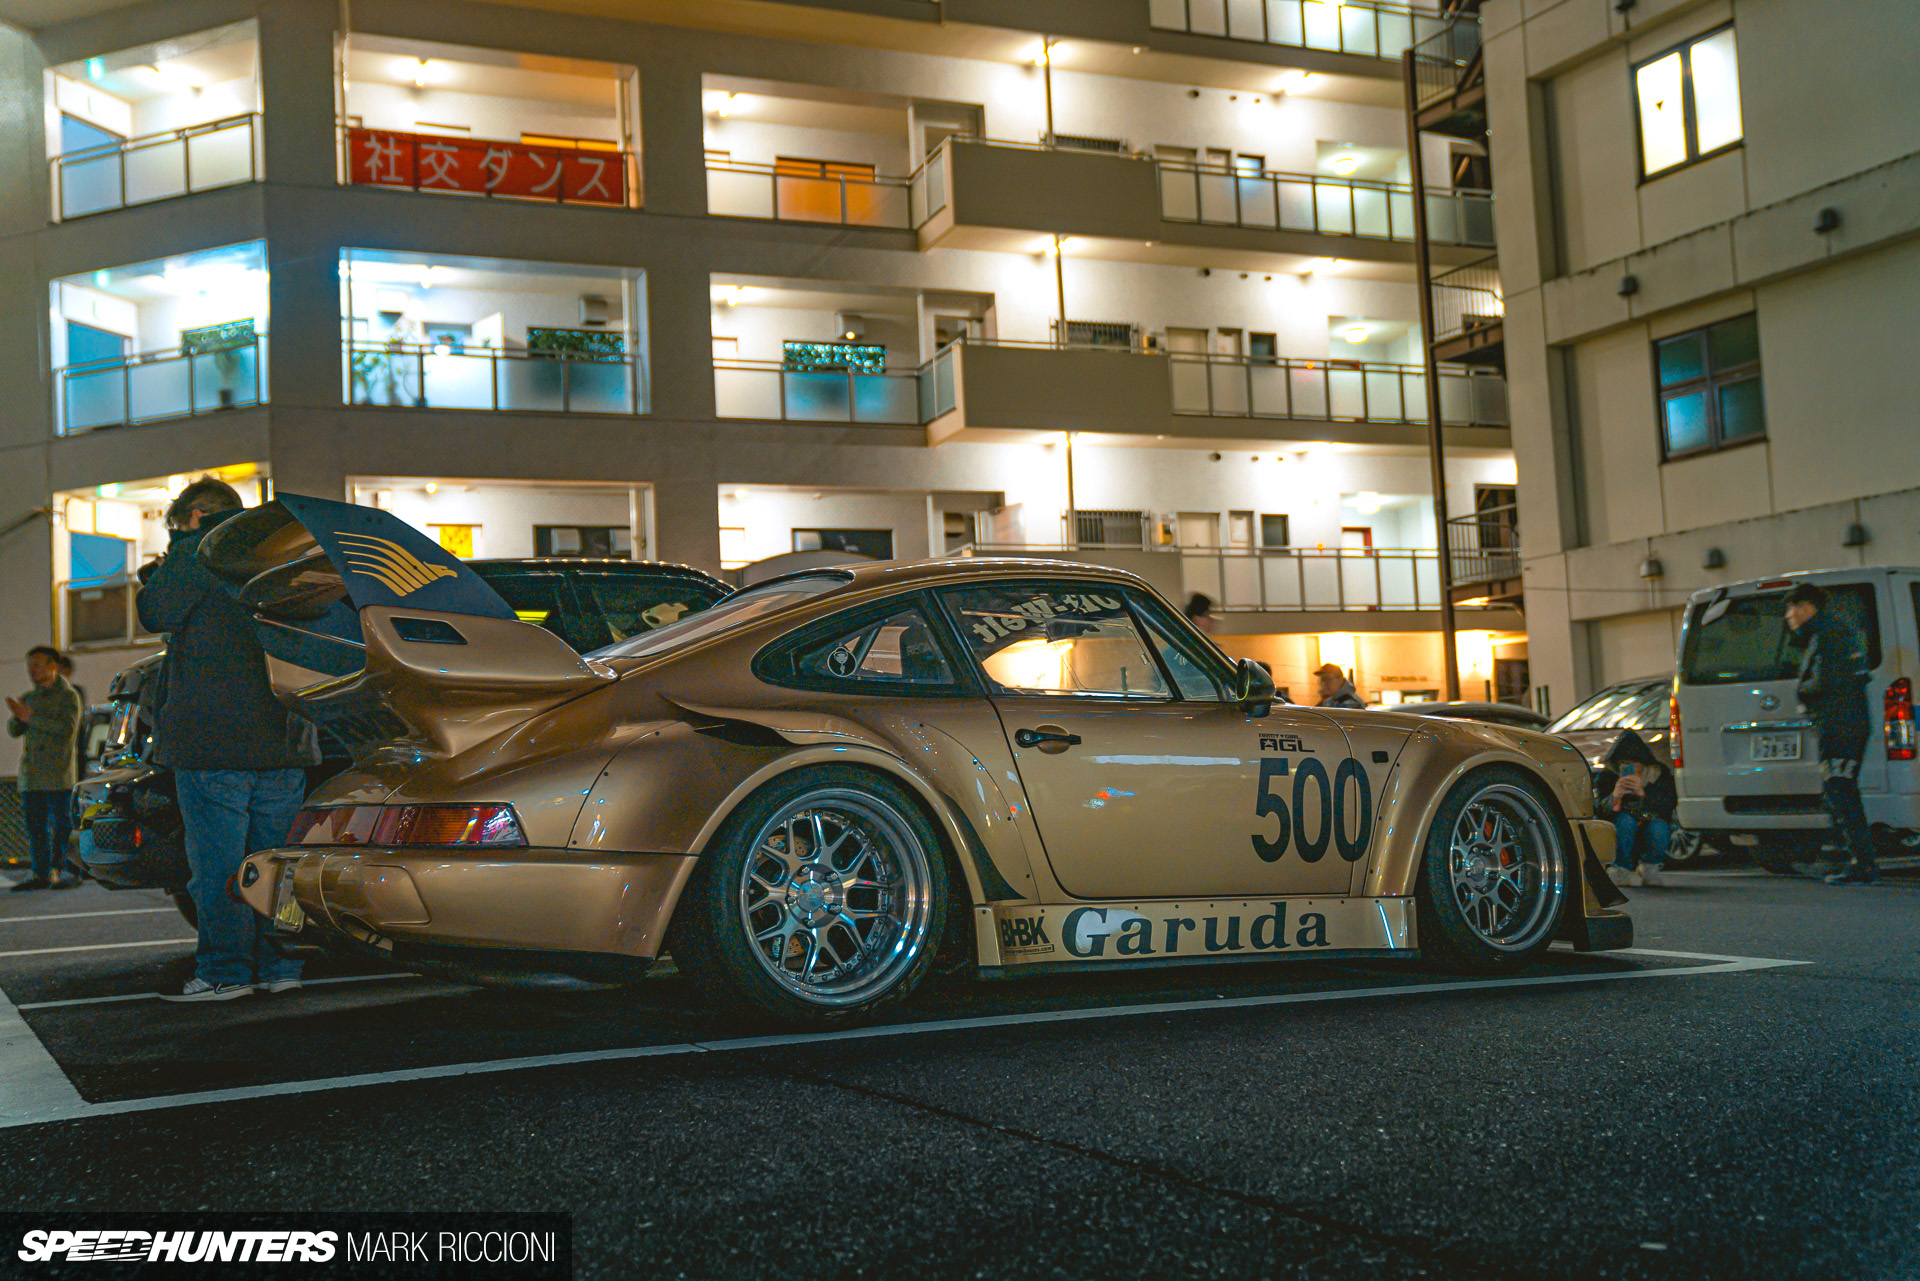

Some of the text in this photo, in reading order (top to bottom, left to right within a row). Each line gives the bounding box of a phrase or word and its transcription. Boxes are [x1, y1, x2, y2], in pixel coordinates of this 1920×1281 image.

[364, 134, 610, 198] 社交ダンス
[1260, 738, 1315, 753] AGL
[1251, 757, 1372, 863] 500
[1062, 901, 1331, 958] Garuda
